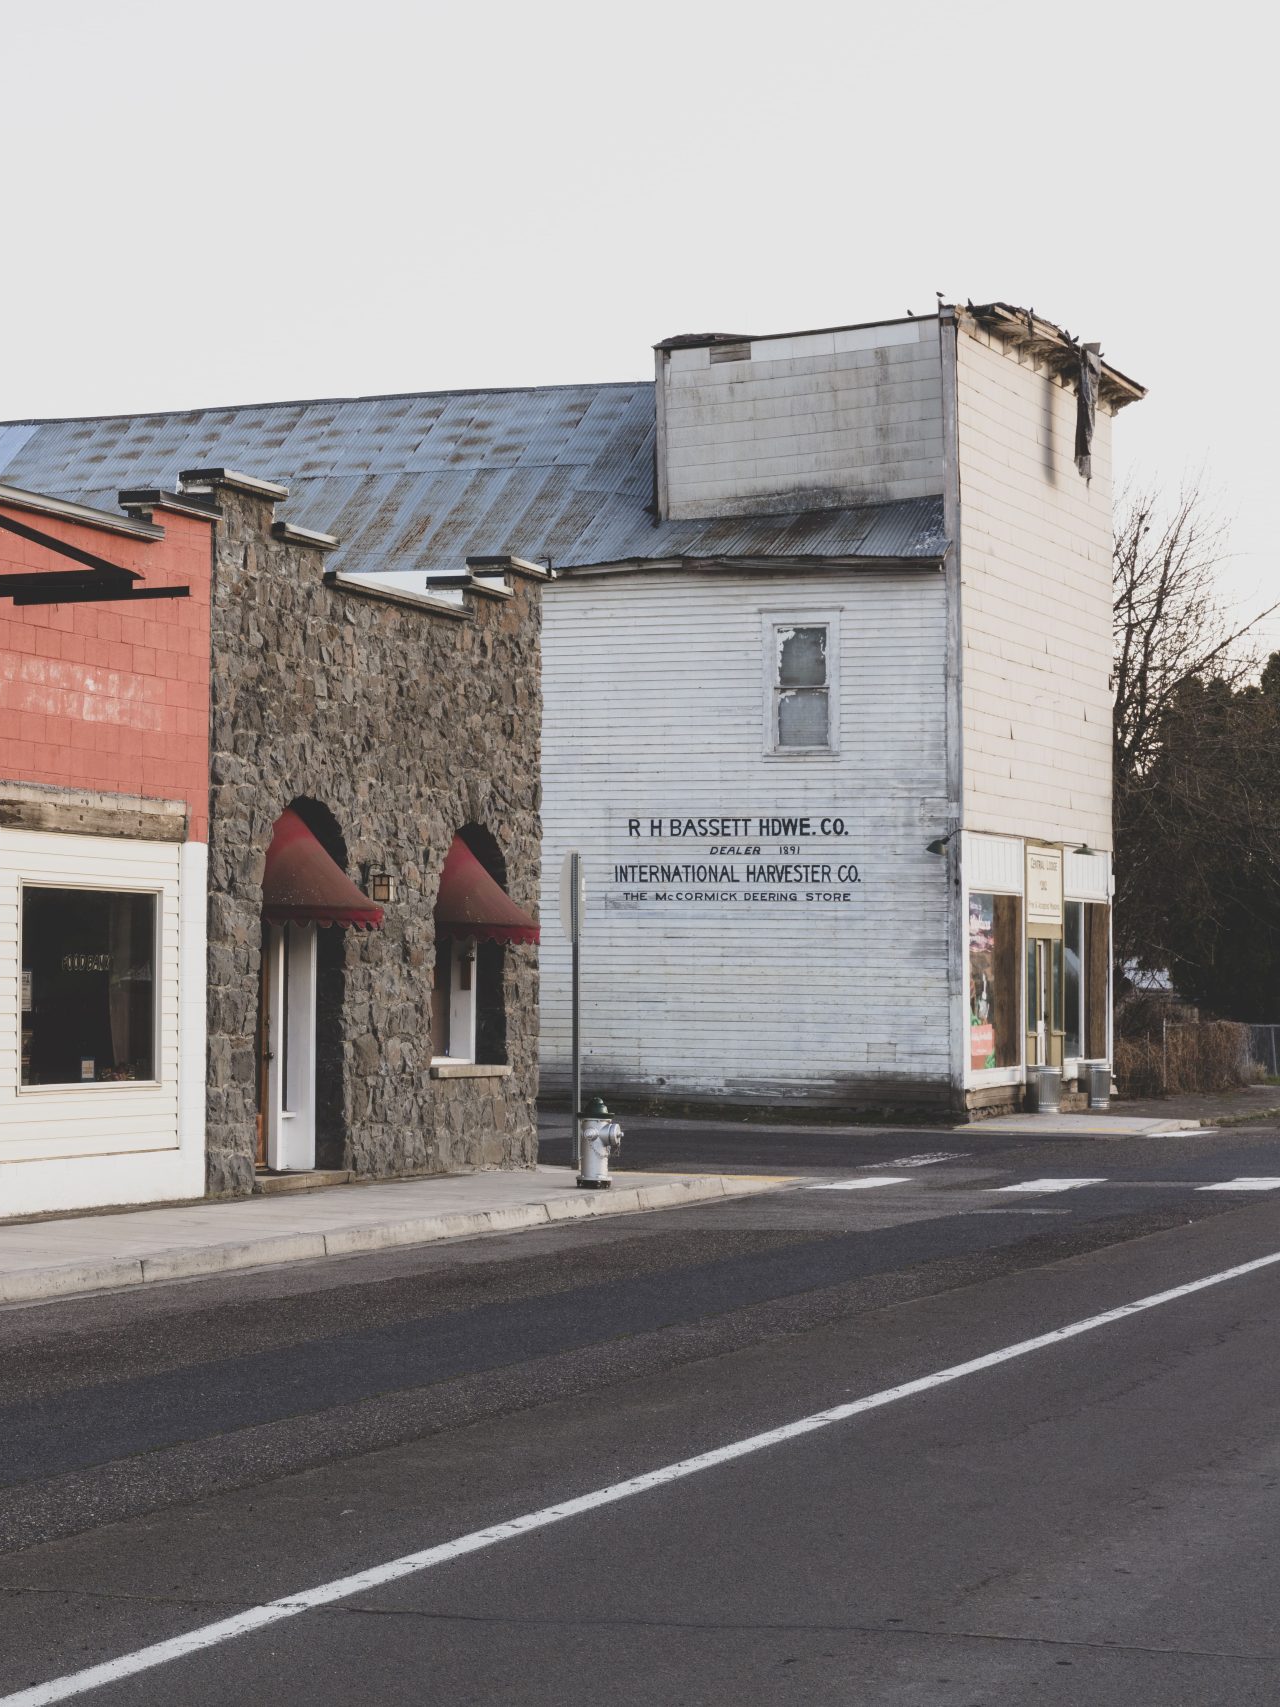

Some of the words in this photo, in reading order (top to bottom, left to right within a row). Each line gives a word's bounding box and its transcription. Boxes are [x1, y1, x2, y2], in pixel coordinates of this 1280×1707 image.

[628, 818, 641, 837] R
[650, 818, 663, 837] H
[670, 818, 752, 837] BASSETT
[759, 817, 816, 836] HDWE.
[820, 817, 849, 836] CO.
[709, 846, 761, 855] DEALER
[779, 845, 800, 855] 1891
[614, 864, 740, 883] INTERNATIONAL
[746, 864, 831, 883] HARVESTER
[837, 864, 862, 883] CO.
[623, 892, 648, 901] THE
[655, 892, 738, 901] McCORMICK
[743, 892, 797, 902] DEERING
[805, 892, 851, 902] STORE
